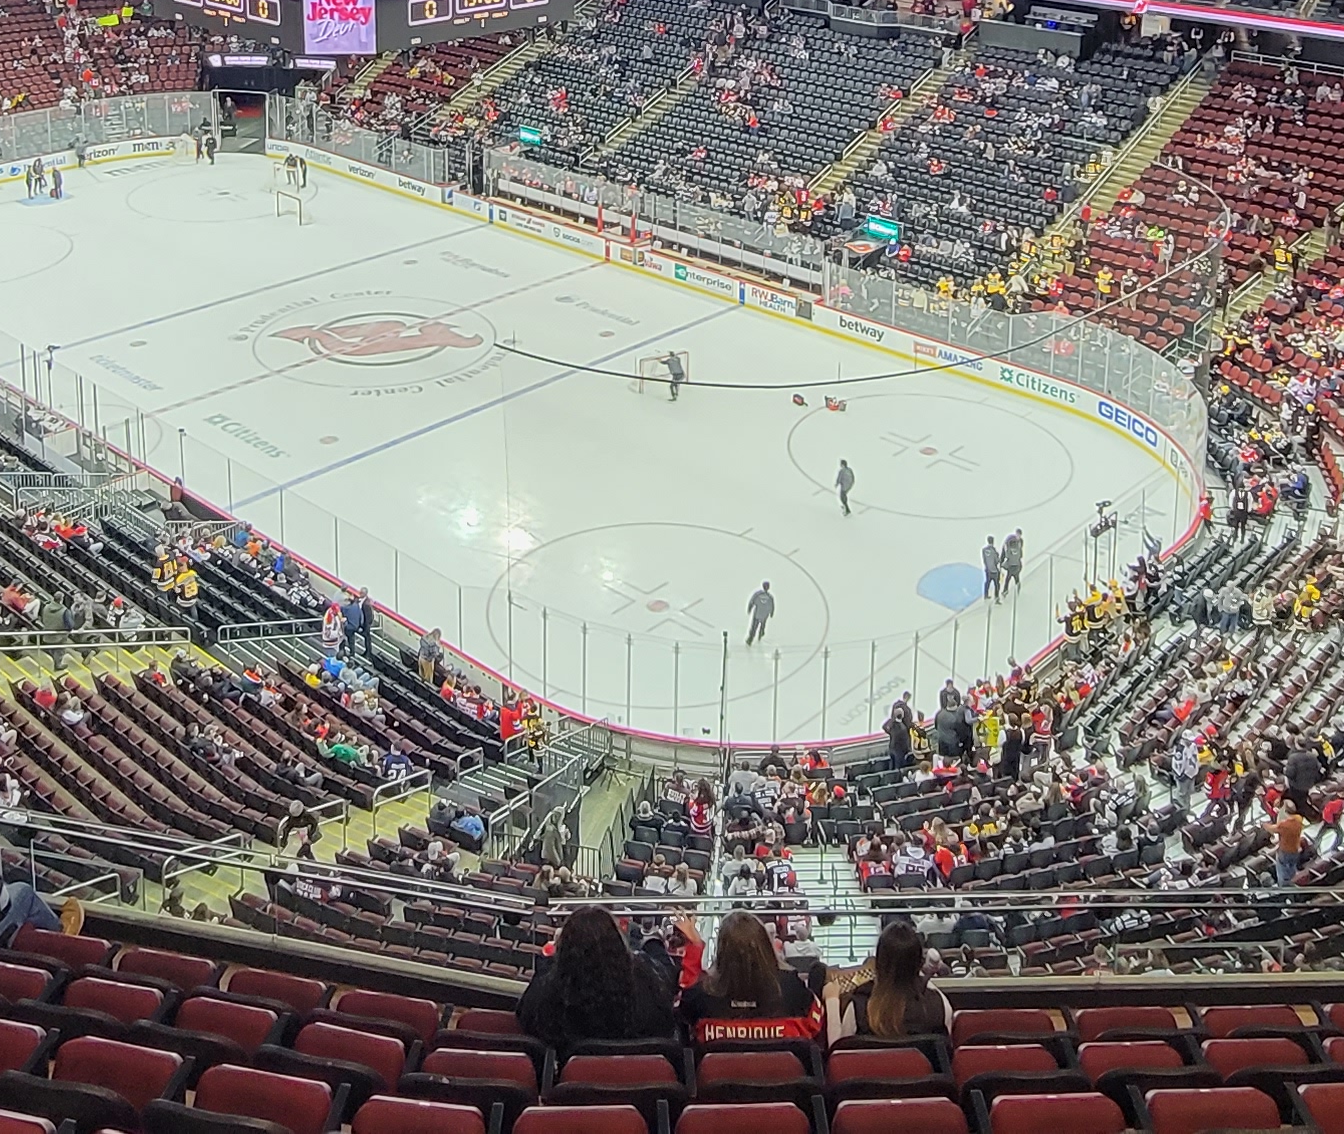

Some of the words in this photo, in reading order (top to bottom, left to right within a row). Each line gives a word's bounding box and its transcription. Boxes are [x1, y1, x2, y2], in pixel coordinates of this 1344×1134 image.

[258, 0, 269, 18] 0
[307, 2, 372, 25] Jersey
[425, 0, 437, 18] 0
[347, 166, 374, 179] verizon
[398, 177, 425, 195] betway
[244, 296, 320, 338] Prudential
[330, 289, 392, 299] Center
[759, 300, 786, 313] HEALTH
[839, 316, 885, 342] betway
[1016, 373, 1076, 403] Citizens
[1098, 401, 1158, 447] GEICO
[222, 419, 286, 459] Citizens
